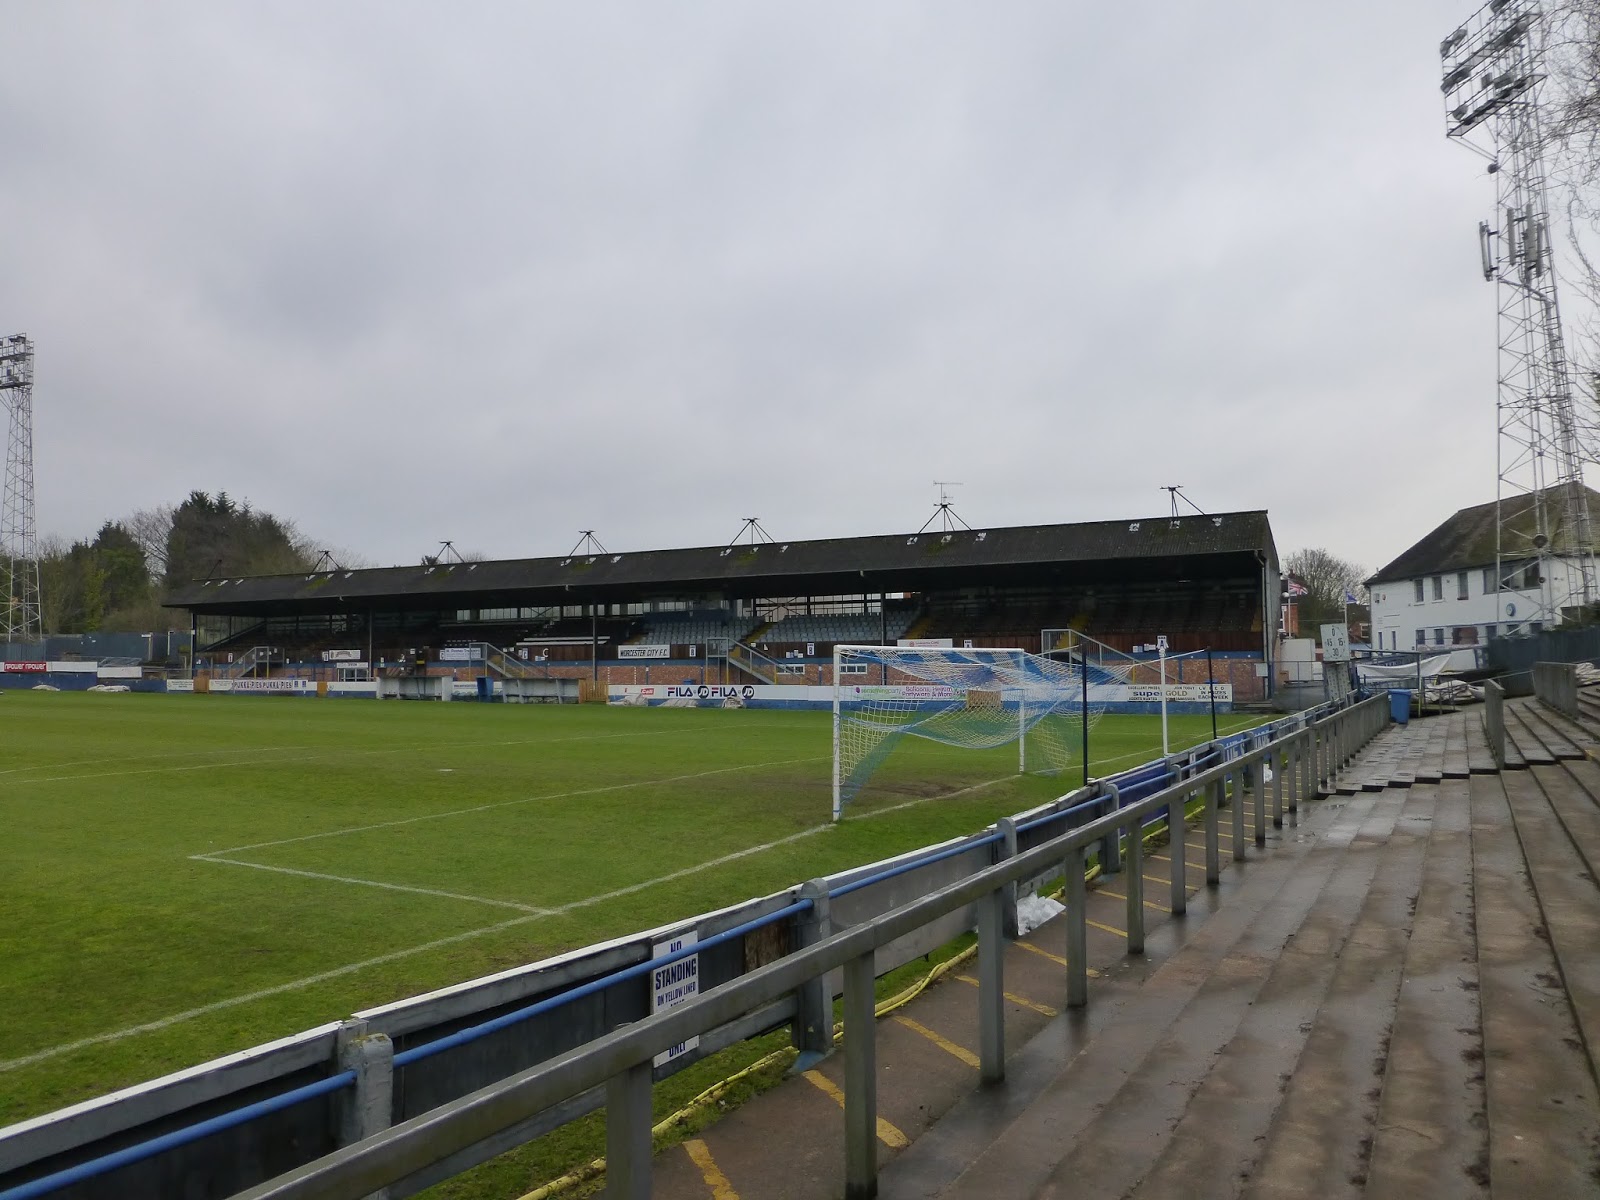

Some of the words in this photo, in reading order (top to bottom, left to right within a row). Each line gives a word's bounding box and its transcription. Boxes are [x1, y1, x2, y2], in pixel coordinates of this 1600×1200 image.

[620, 649, 646, 657] WORCESTER
[646, 649, 659, 657] CITY
[668, 687, 694, 697] FILA
[711, 687, 738, 697] FILA
[655, 957, 697, 991] STANDING
[657, 994, 664, 1007] ON
[665, 986, 683, 1003] YELLOW
